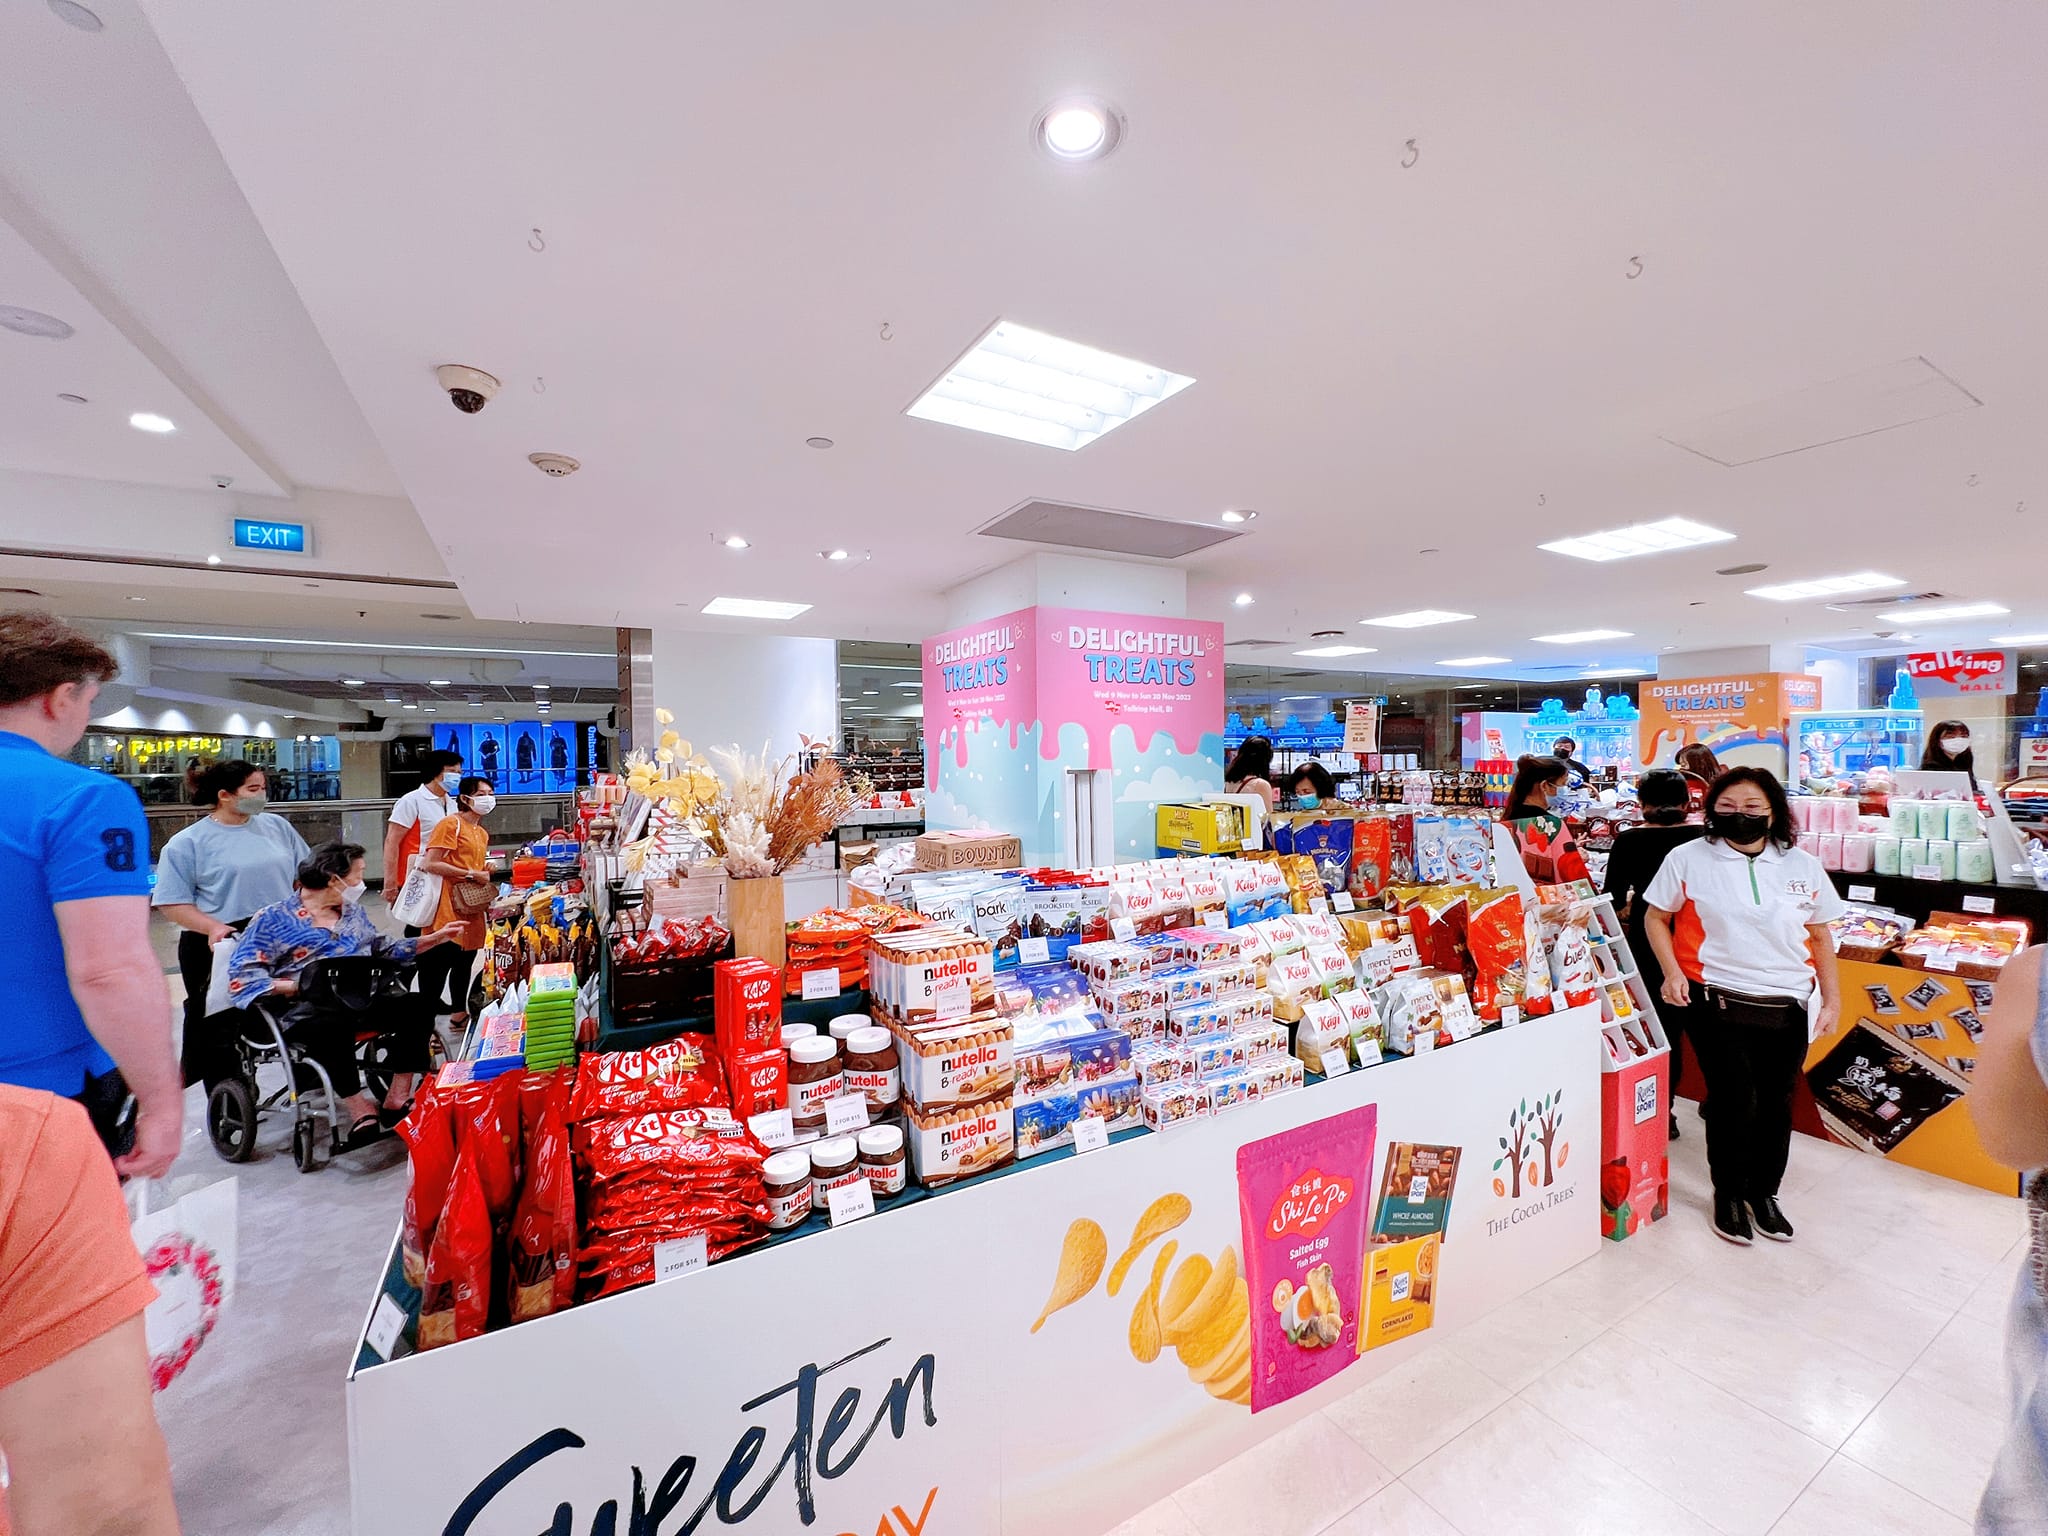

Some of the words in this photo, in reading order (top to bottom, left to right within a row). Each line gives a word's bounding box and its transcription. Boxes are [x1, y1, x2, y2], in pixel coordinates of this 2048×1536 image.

[247, 525, 291, 546] EXIT
[935, 626, 1016, 666] DELIGHTFUL
[1068, 626, 1206, 657] DELIGHTFUL
[1084, 654, 1196, 686] TREATS
[1907, 650, 2002, 674] Talking
[943, 655, 1009, 692] TREATS
[1652, 681, 1755, 698] DELIGHTFUL
[1960, 683, 2005, 692] HALL
[1663, 695, 1747, 712] TREATS
[952, 843, 1017, 864] BOUNTY
[1235, 878, 1258, 893] Kägi
[1260, 873, 1281, 886] Kägi
[1194, 883, 1217, 896] Kägi
[1034, 902, 1074, 910] BROOKSIDE
[1127, 894, 1153, 909] Kägi
[1271, 929, 1295, 943] Kägi
[1308, 925, 1330, 939] Kägi
[1392, 944, 1413, 959] erci
[1563, 945, 1587, 967] buen
[924, 958, 978, 980] nutella
[1322, 956, 1346, 971] Kägi
[1367, 956, 1391, 970] merci
[1286, 965, 1311, 979] Kägi
[746, 980, 771, 999] KitKat
[746, 1000, 770, 1011] Singles
[1351, 1005, 1372, 1020] Kägi
[1446, 1004, 1468, 1019] erci
[1317, 1015, 1341, 1031] Kägi
[609, 1043, 680, 1083] KitKat
[941, 1047, 998, 1072] nutella
[751, 1067, 778, 1088] KitKat
[845, 1075, 888, 1087] nutella
[753, 1088, 778, 1099] Singles
[801, 1079, 842, 1100] nutella
[1636, 1099, 1655, 1114] SPORT
[623, 1108, 699, 1146] KitKat
[941, 1117, 997, 1144] nutella
[782, 1182, 812, 1211] nutell
[1273, 1200, 1305, 1232] Shi
[1322, 1184, 1348, 1214] Po
[1392, 1212, 1410, 1220] WHOLE
[1411, 1212, 1434, 1220] ALMONDS
[1486, 1217, 1509, 1237] THE
[1511, 1201, 1545, 1224] COCOA
[1546, 1186, 1574, 1208] TREES
[1290, 1241, 1314, 1260] Salted
[1315, 1236, 1329, 1250] Egg
[670, 1263, 684, 1272] FOR
[686, 1257, 698, 1266] $14
[1296, 1258, 1308, 1270] Fish
[1310, 1253, 1322, 1264] Skin
[1382, 1313, 1414, 1329] CORNFLAKES
[836, 1487, 938, 1536] AY
